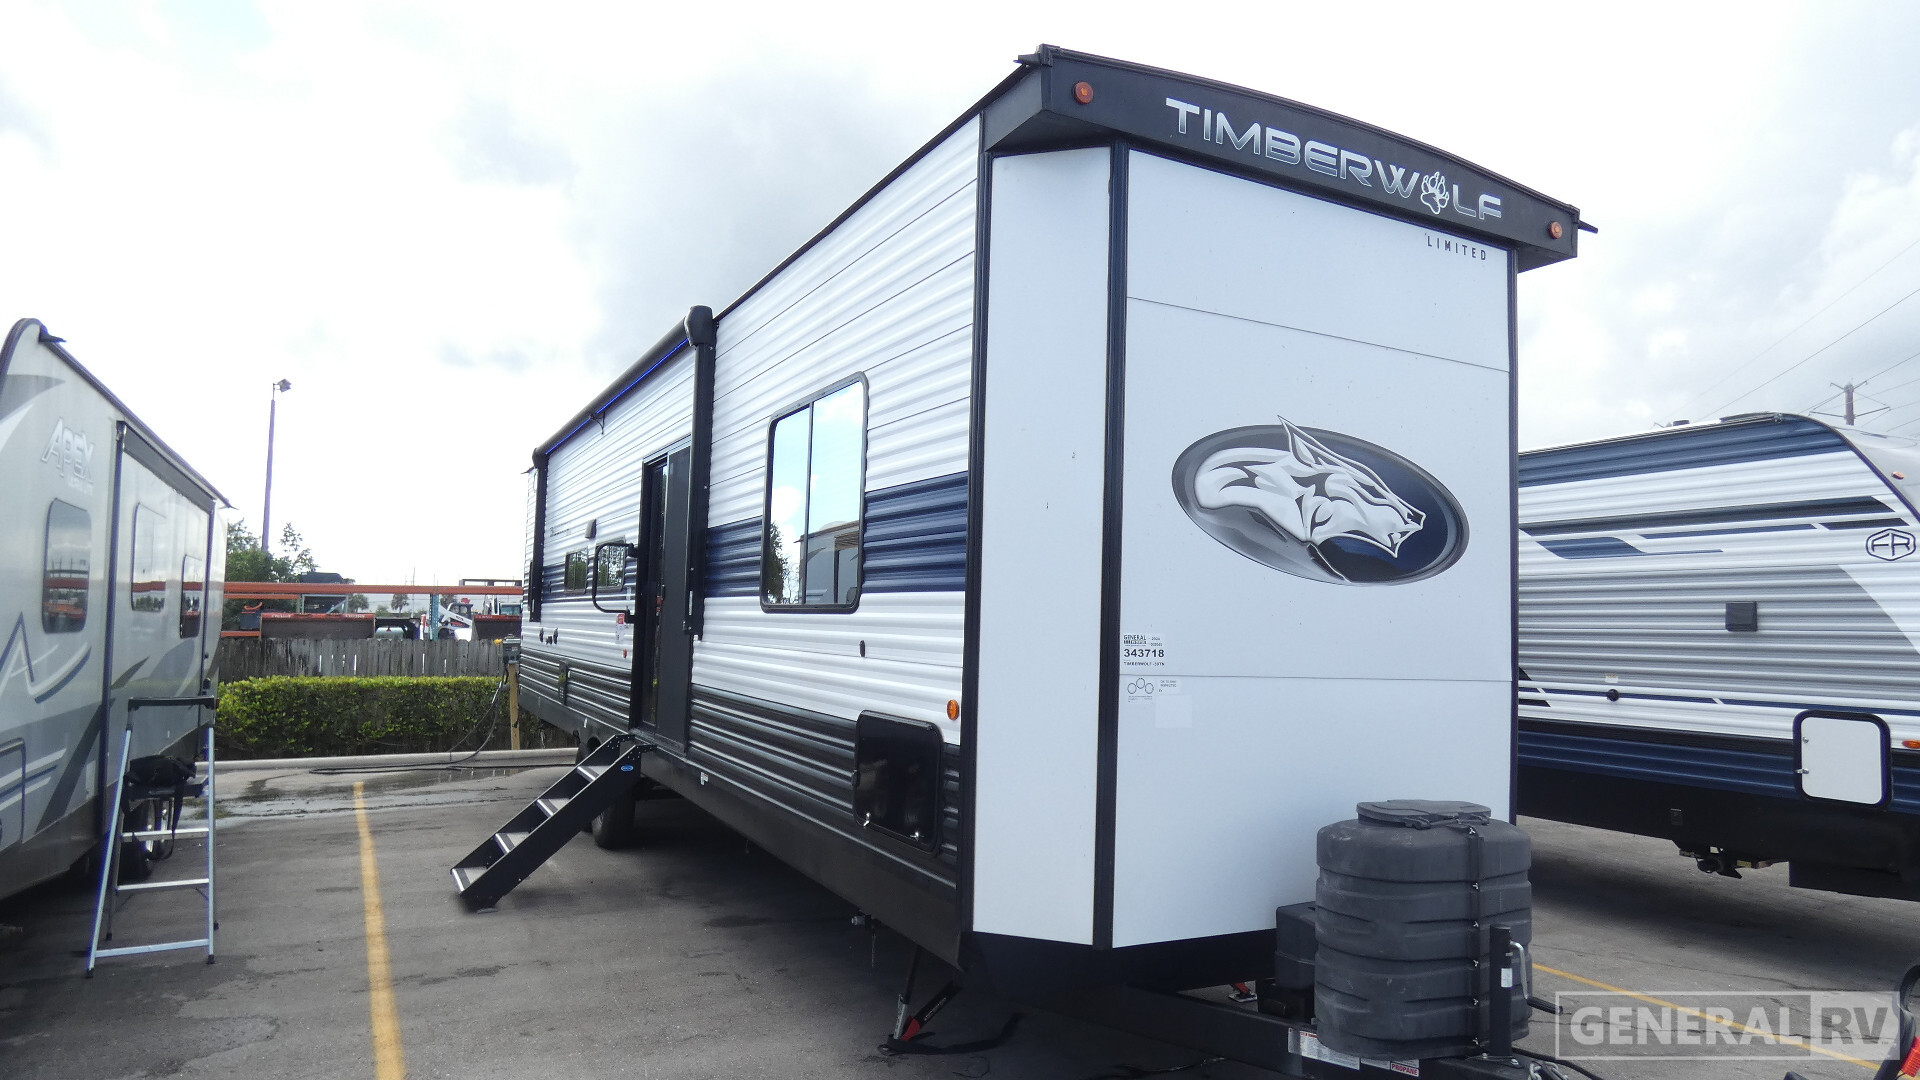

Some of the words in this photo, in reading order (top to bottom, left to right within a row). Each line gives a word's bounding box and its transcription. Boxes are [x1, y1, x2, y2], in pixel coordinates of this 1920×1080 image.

[1426, 234, 1487, 261] LIMITED
[41, 417, 95, 485] APEX
[1123, 648, 1165, 658] 343718
[1391, 1063, 1418, 1076] PROPANE
